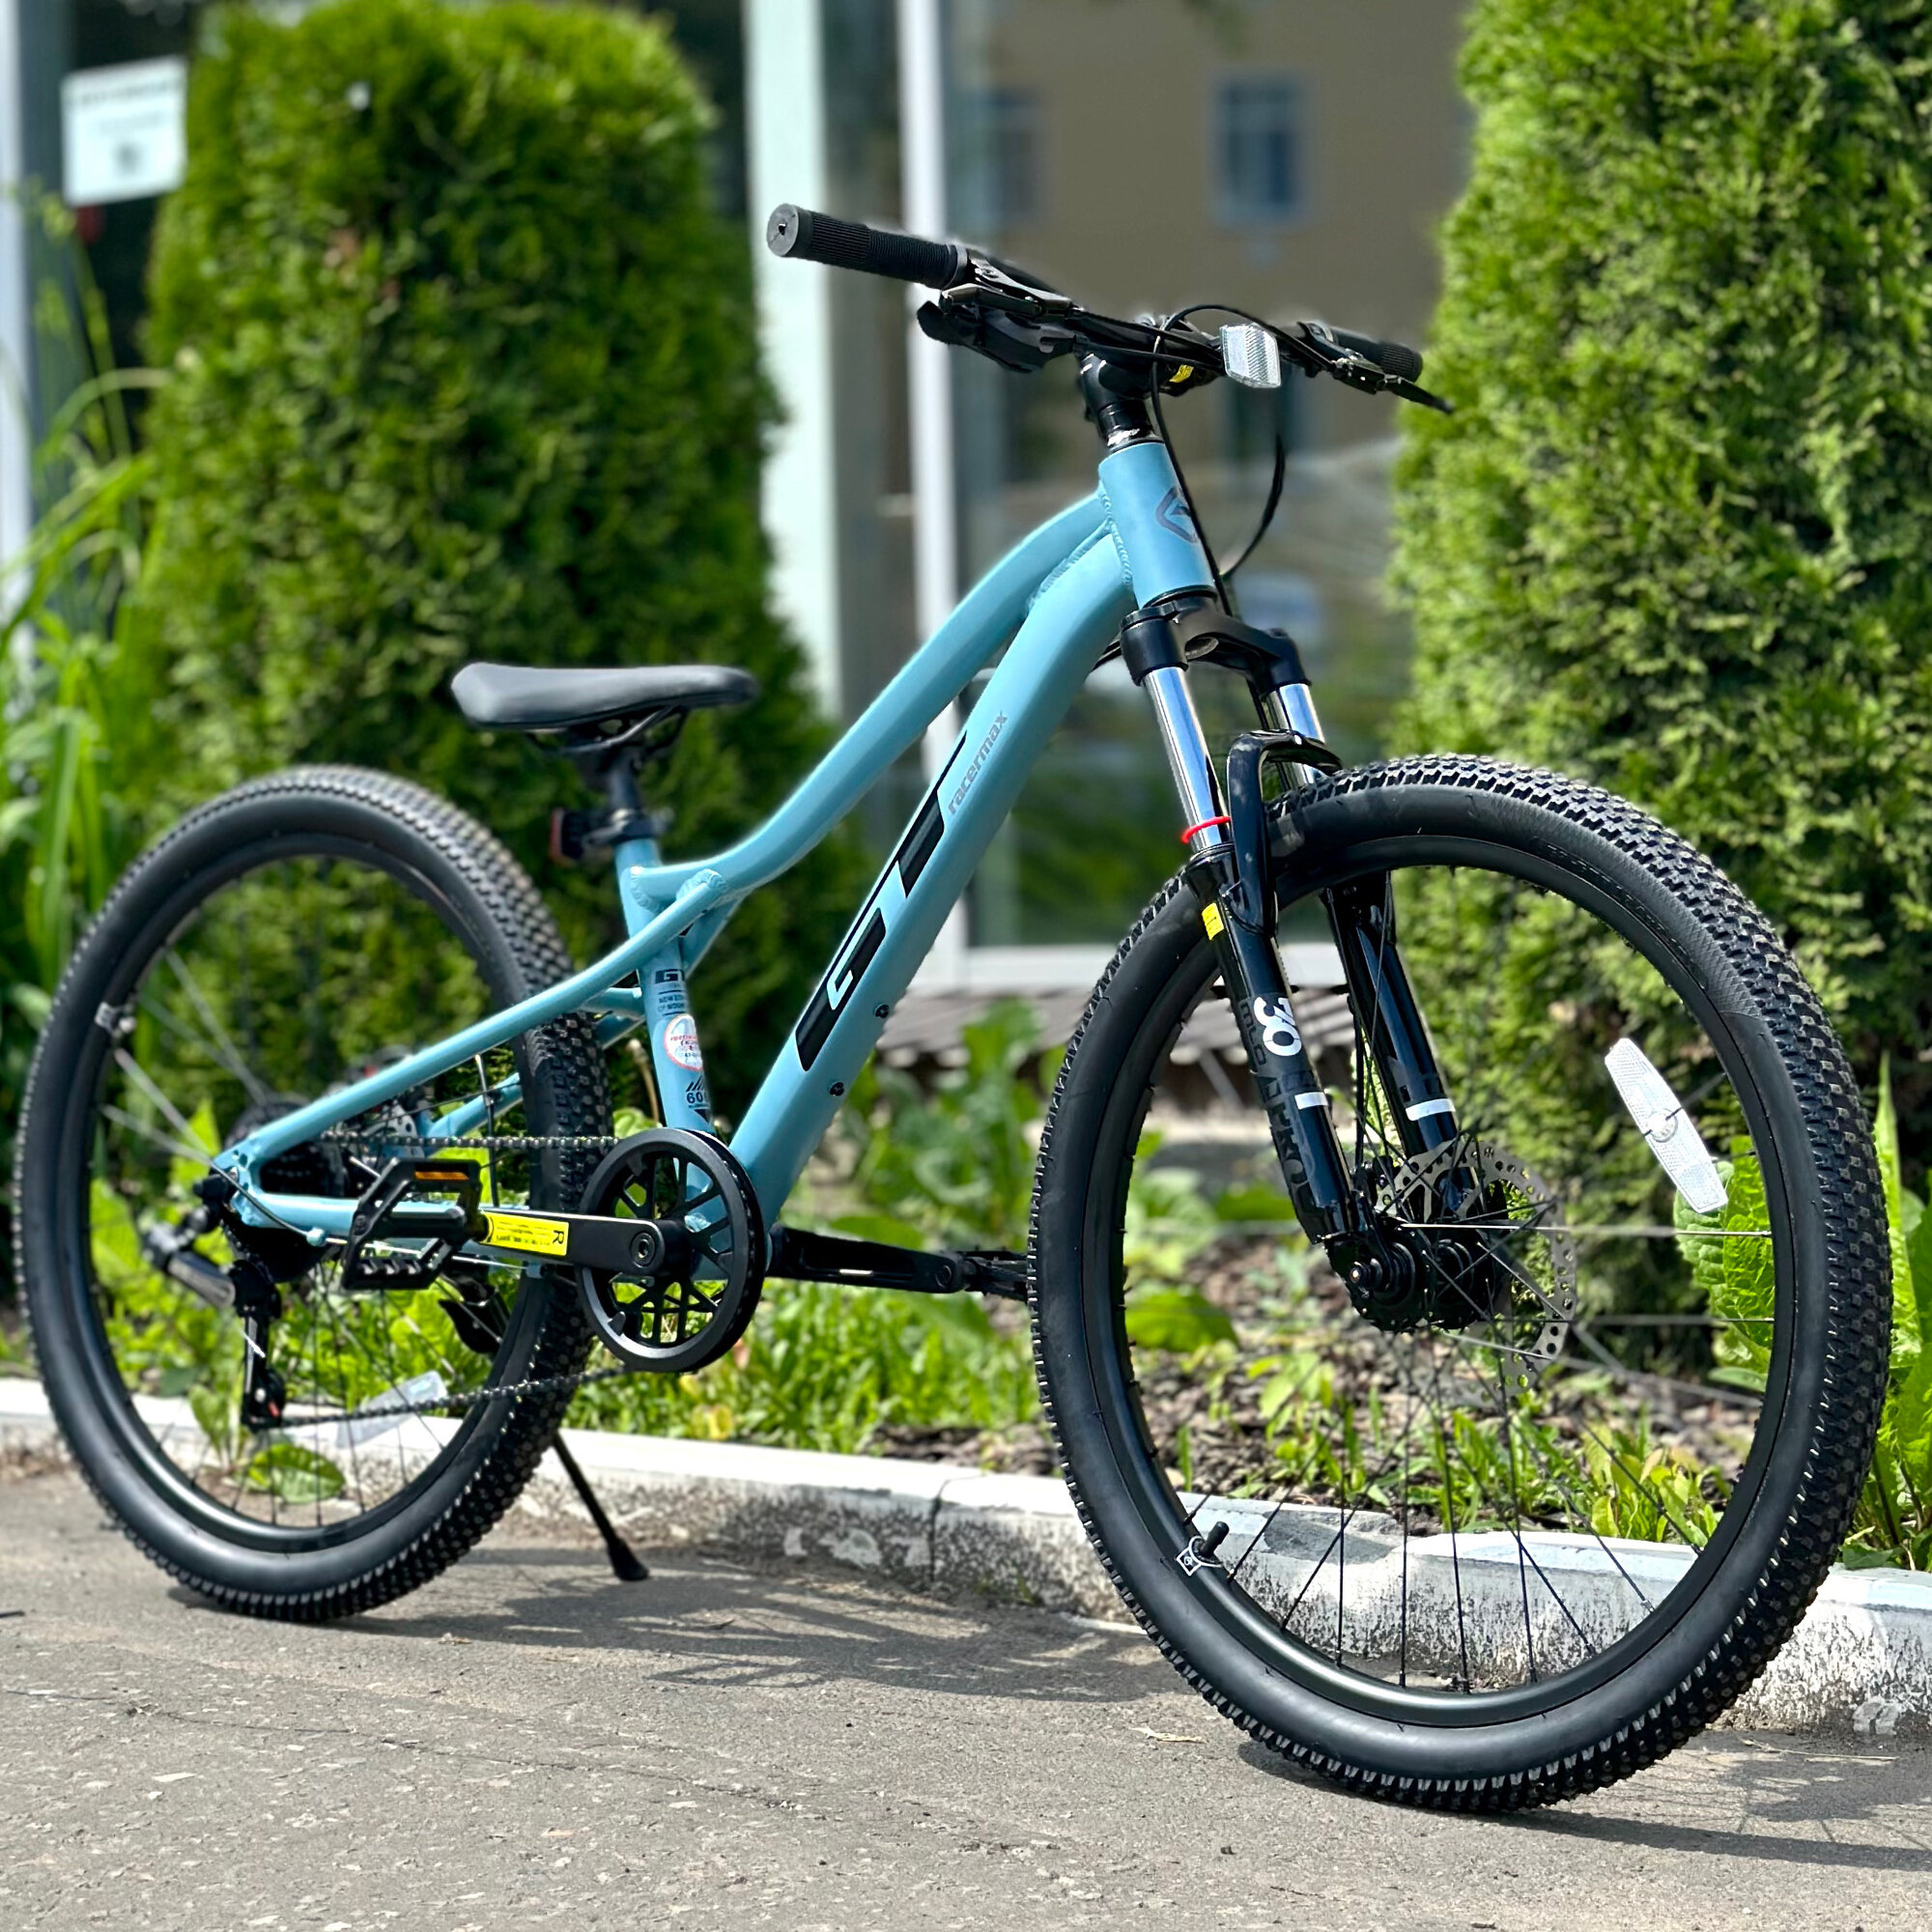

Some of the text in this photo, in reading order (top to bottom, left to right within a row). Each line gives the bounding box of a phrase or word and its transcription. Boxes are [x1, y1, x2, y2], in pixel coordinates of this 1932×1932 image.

[948, 711, 1008, 815] racermax
[1254, 997, 1302, 1056] 30
[553, 1230, 564, 1245] R
